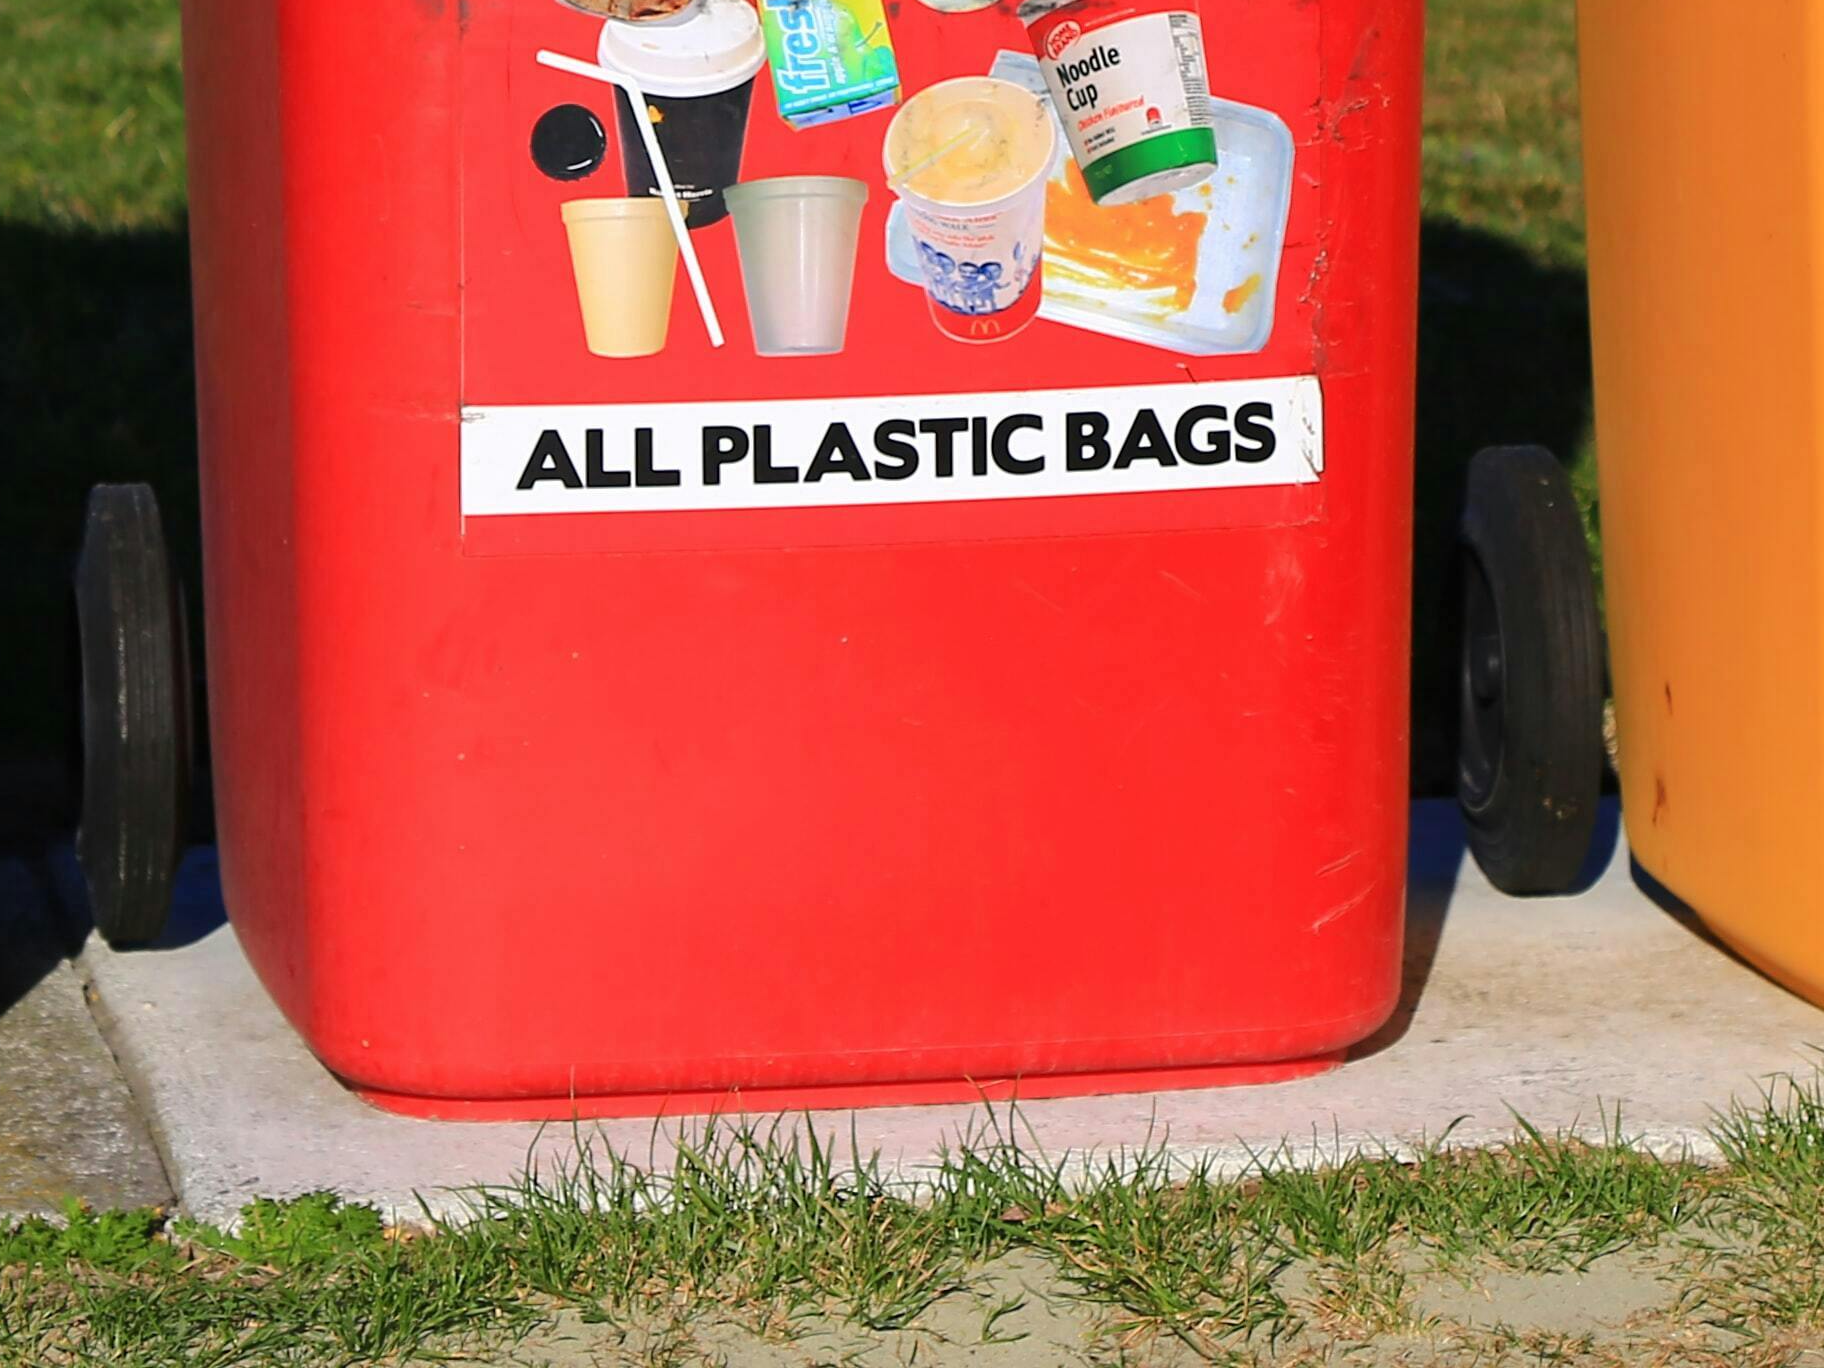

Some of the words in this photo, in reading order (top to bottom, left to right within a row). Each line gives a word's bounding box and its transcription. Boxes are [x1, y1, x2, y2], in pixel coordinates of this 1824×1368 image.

[1056, 45, 1121, 88] Noodle
[1066, 83, 1099, 112] Cup
[516, 428, 681, 490] ALL
[701, 413, 1046, 487] PLASTIC
[1065, 401, 1277, 473] BAGS
